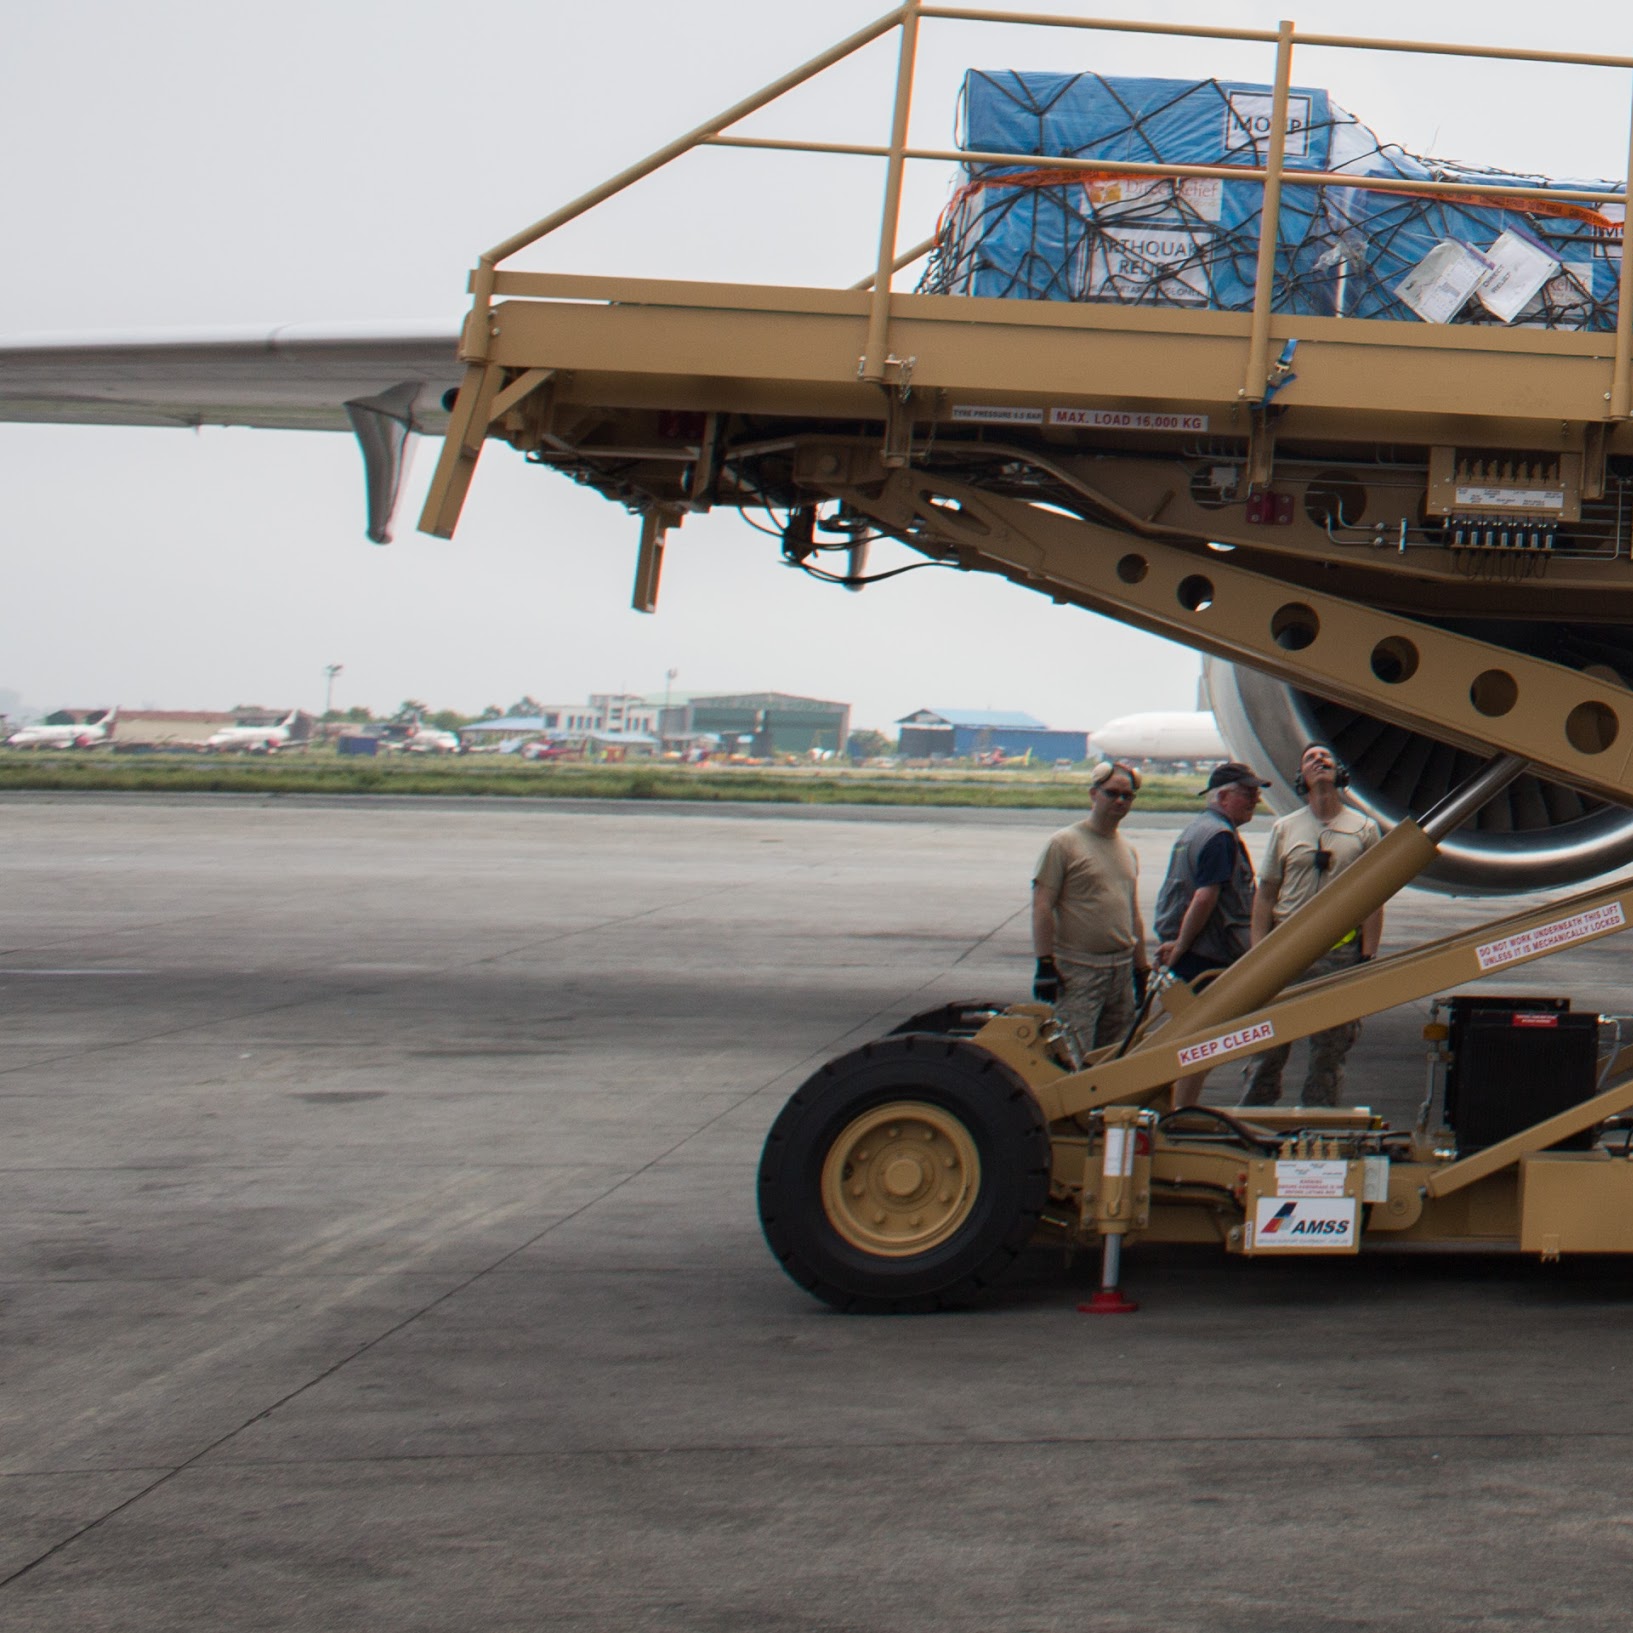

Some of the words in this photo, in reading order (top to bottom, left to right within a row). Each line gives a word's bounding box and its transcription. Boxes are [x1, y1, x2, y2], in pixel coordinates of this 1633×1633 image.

[1234, 115, 1302, 134] MOP
[1056, 411, 1090, 424] MAX.
[1094, 412, 1131, 426] LOAD
[1136, 414, 1178, 429] 16,000
[1182, 416, 1202, 429] KG
[1483, 950, 1513, 967] UNLESS
[1513, 946, 1522, 956] IT
[1523, 944, 1531, 954] IS
[1532, 926, 1590, 951] MECHANICALLY
[1591, 915, 1621, 932] LOCKED
[1493, 941, 1508, 953] NOT
[1510, 934, 1532, 947] WORK
[1534, 918, 1583, 940] UNDERNEATH
[1584, 911, 1601, 923] THIS
[1603, 904, 1618, 917] LIFT
[1180, 1041, 1218, 1063] KEEP
[1223, 1024, 1271, 1049] CLEAR
[1291, 1220, 1350, 1235] AMSS
